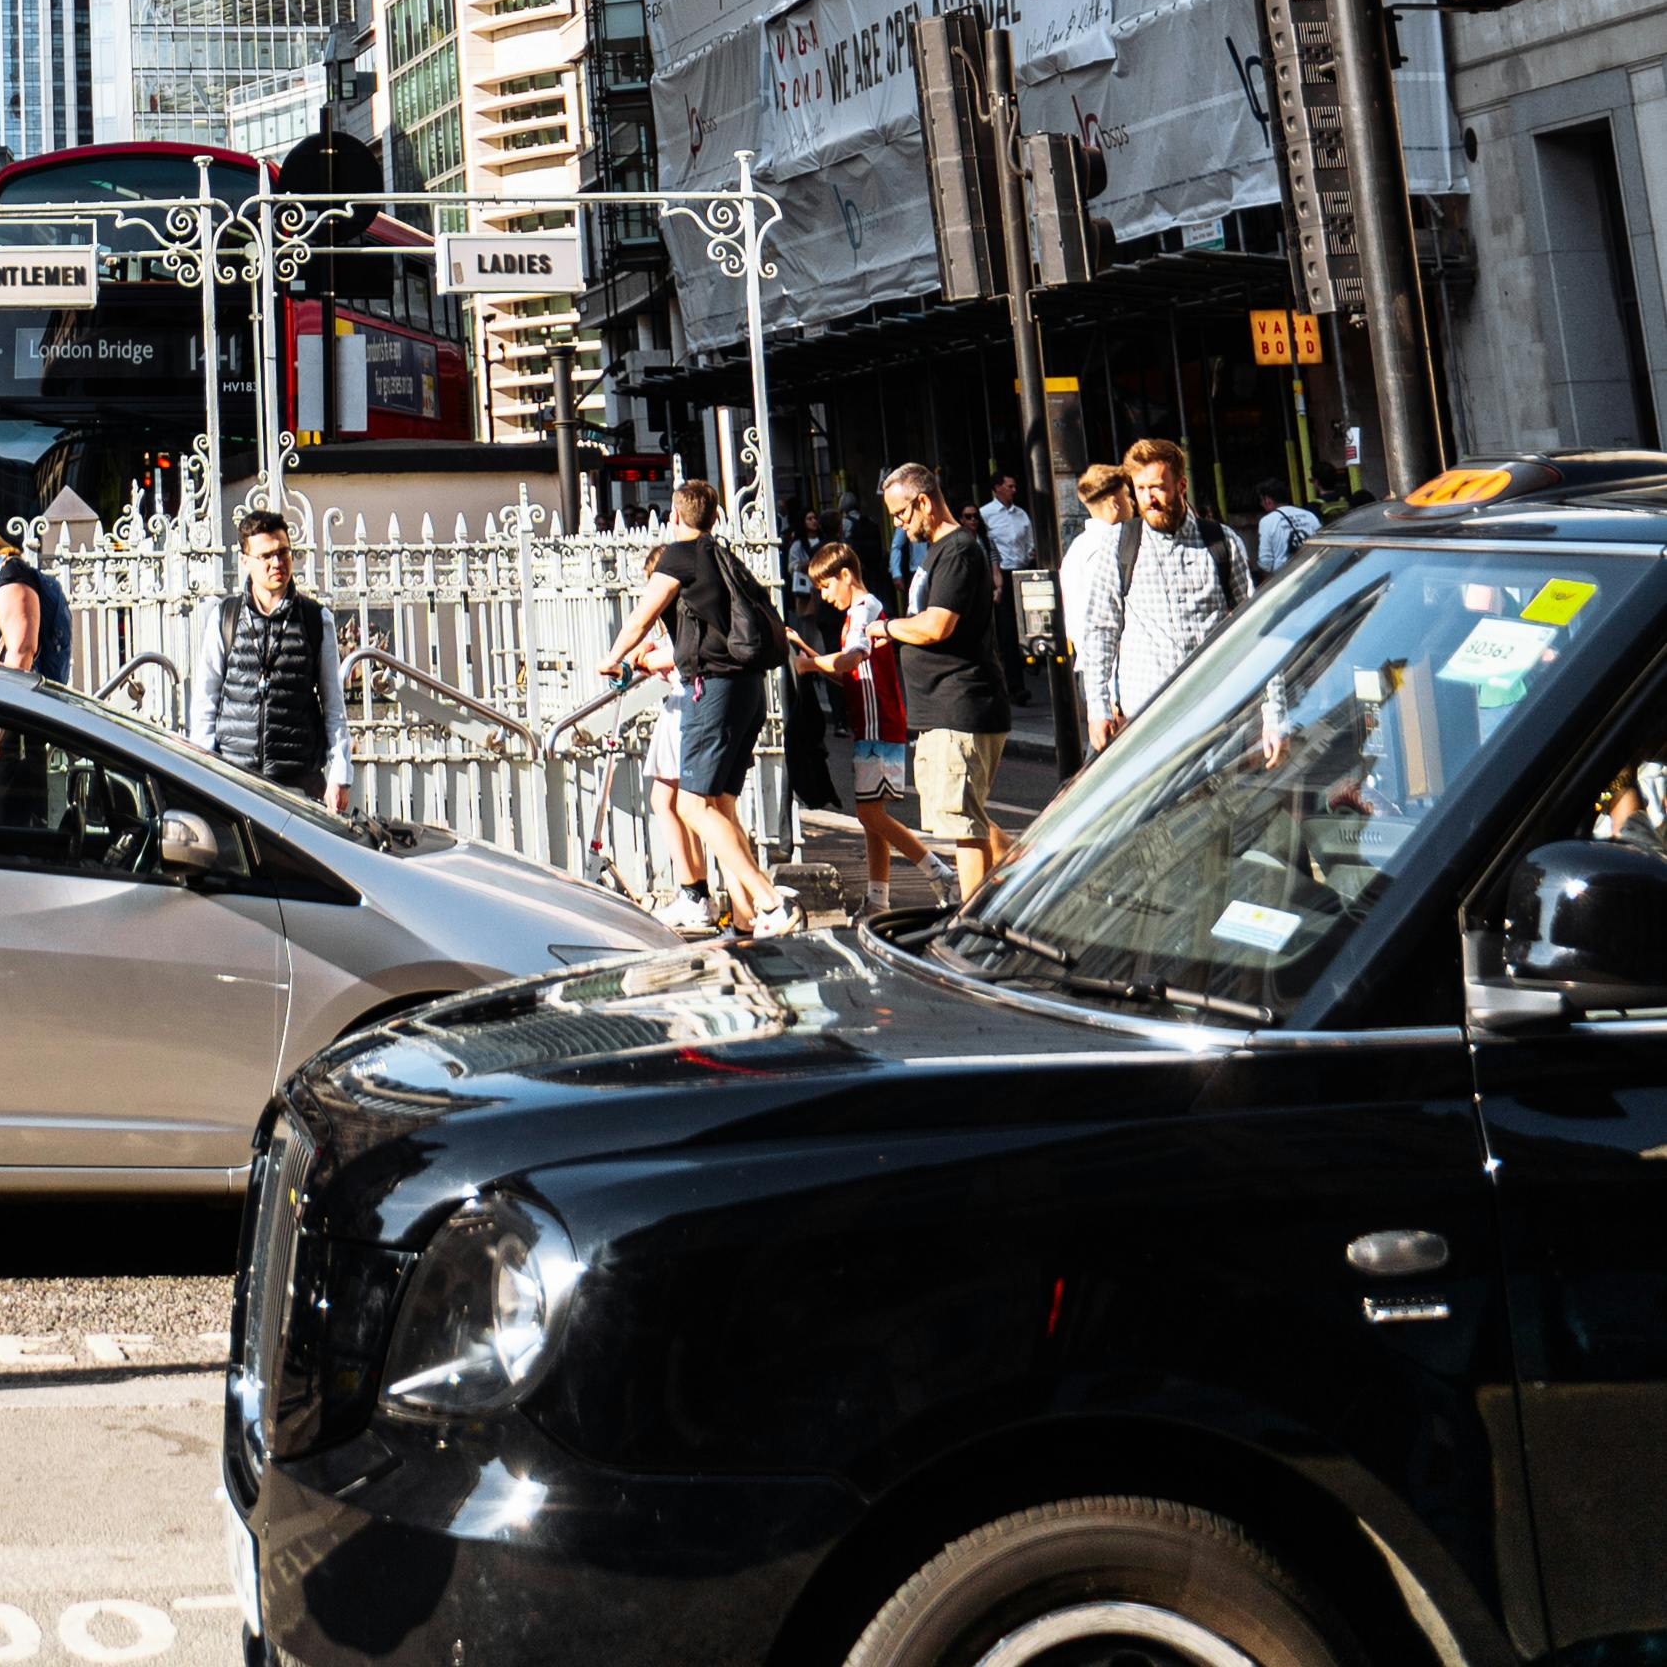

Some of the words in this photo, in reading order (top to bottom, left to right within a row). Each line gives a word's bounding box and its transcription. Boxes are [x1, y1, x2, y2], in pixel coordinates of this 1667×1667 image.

[825, 39, 852, 106] WE
[853, 22, 883, 95] ARE
[1102, 121, 1130, 153] bsps
[478, 253, 553, 275] LADIES
[1258, 320, 1312, 335] VAA
[29, 339, 92, 359] London
[98, 339, 154, 364] Bridge
